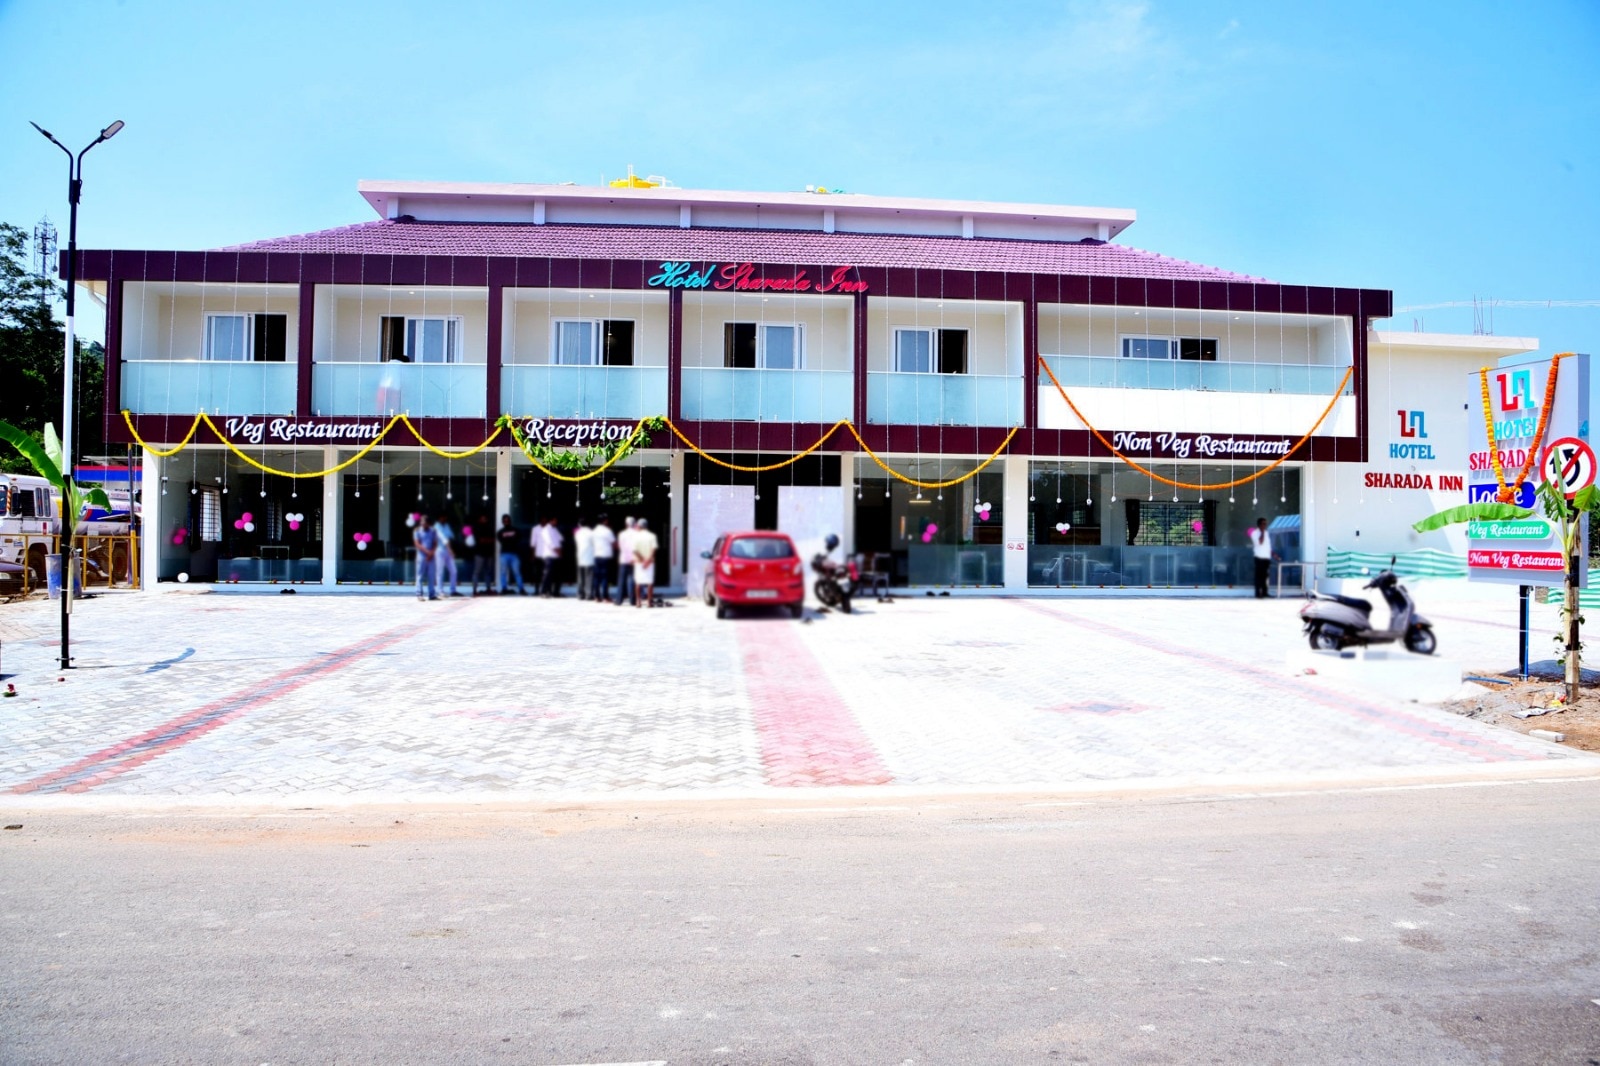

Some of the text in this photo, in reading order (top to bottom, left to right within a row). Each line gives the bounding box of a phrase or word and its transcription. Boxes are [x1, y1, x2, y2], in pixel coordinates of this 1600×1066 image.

[648, 261, 869, 293] Hotel Sharada Inn
[226, 416, 382, 444] Veg Restaurant
[526, 418, 633, 447] Reception
[1113, 432, 1292, 458] Non Veg Restaurant
[1389, 443, 1436, 460] HOTEL
[1469, 448, 1534, 471] SHARAD
[1364, 472, 1463, 491] SHARADA INN
[1471, 486, 1524, 505] Lode
[1470, 523, 1544, 539] Veg Restaurant
[1469, 552, 1489, 564] Non
[1491, 552, 1510, 568] Veg
